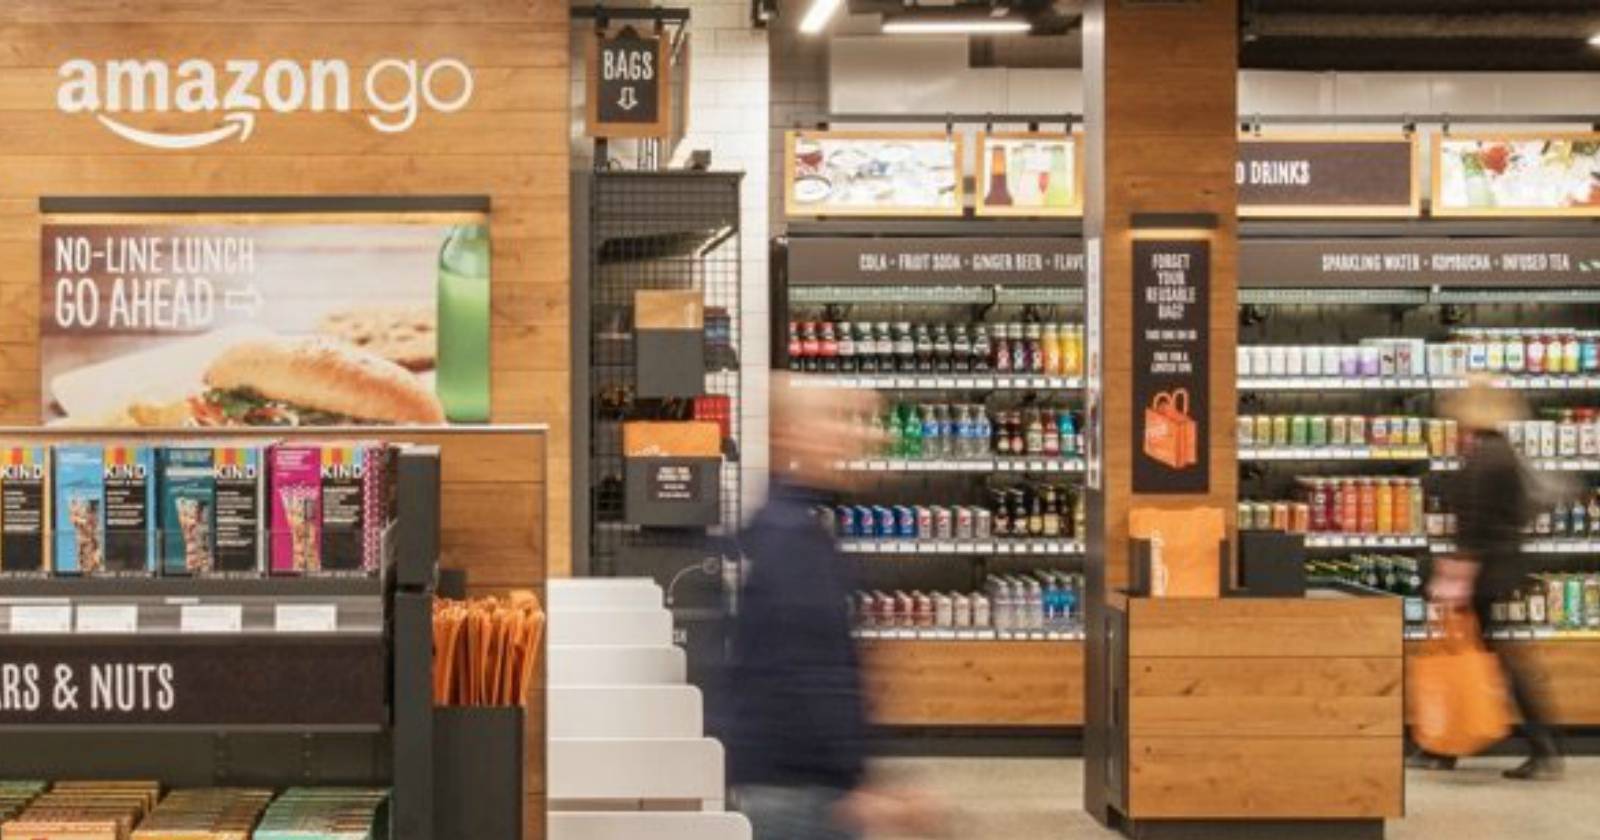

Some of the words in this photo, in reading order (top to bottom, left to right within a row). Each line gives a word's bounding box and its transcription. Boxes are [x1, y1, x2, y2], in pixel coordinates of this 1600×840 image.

[603, 49, 653, 80] BAGS
[57, 58, 350, 113] amazon
[365, 58, 473, 132] go
[1250, 160, 1310, 184] DRINKS
[55, 237, 164, 274] NO-LINE
[171, 236, 255, 274] LUNCH
[859, 253, 887, 271] COLA
[898, 253, 930, 271] FRUIT
[932, 253, 961, 271] SODA
[972, 253, 1012, 271] GINGER
[1015, 253, 1042, 271] BEER
[1152, 253, 1190, 270] FORGET
[1322, 253, 1381, 271] SPARKLING
[1384, 253, 1420, 271] WATER
[1432, 253, 1491, 271] KOMBUCHA
[1502, 253, 1548, 271] INFUSED
[1548, 253, 1570, 271] TEA
[1157, 270, 1185, 286] YOUR
[55, 278, 99, 328] GO
[108, 278, 214, 328] AHEAD
[1145, 286, 1196, 304] REUSABLE
[0, 464, 43, 479] KIND
[103, 464, 147, 479] KIND
[214, 464, 257, 479] KIND
[320, 464, 364, 479] KIND
[0, 663, 40, 710] RS
[53, 663, 78, 710] &
[91, 664, 174, 710] NUTS
